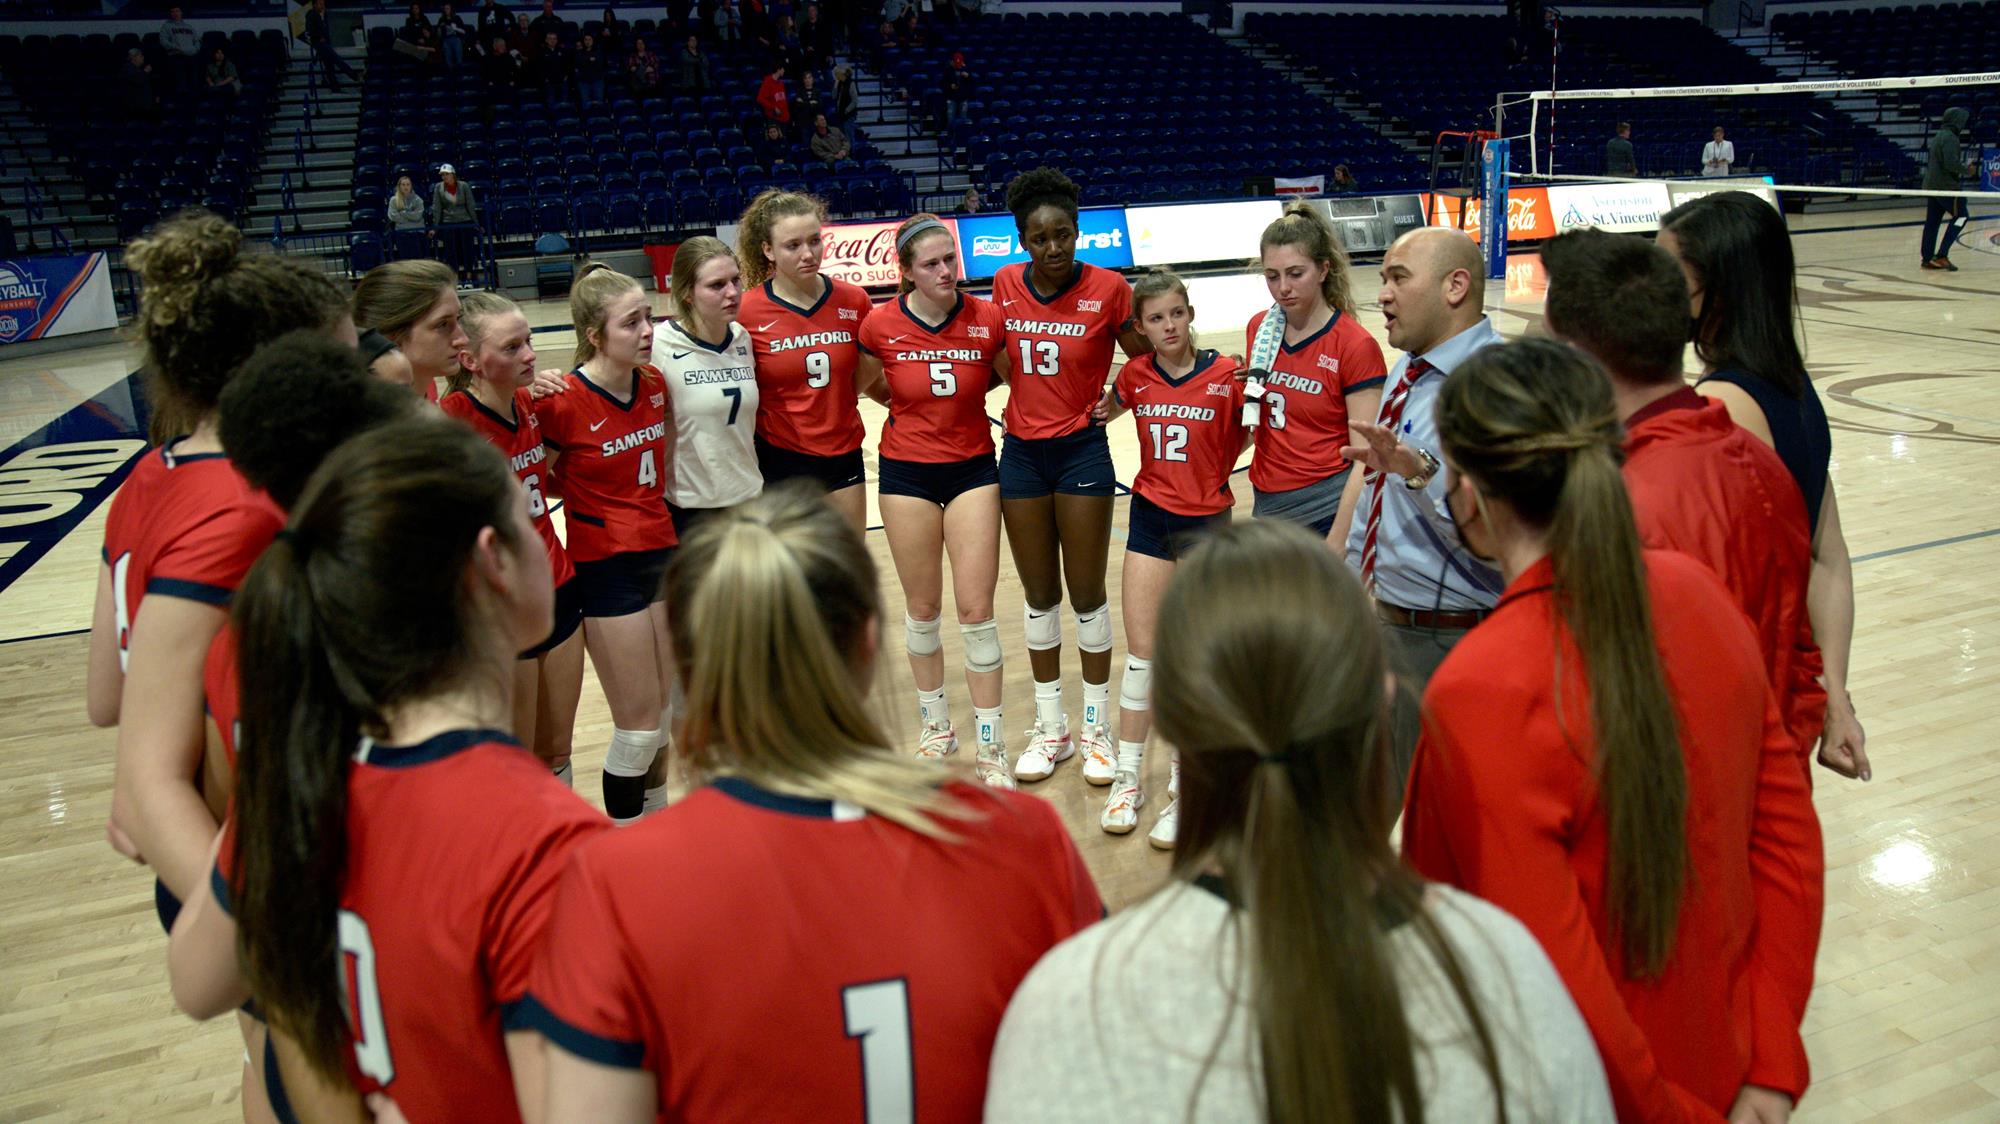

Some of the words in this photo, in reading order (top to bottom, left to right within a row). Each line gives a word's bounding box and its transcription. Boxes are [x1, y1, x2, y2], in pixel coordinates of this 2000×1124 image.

[1847, 80, 1882, 88] VOLLEYBALL
[1945, 75, 1981, 84] SOUTHERN
[1393, 215, 1416, 225] GUEST
[828, 270, 862, 283] ero
[866, 269, 901, 282] SUG
[0, 283, 42, 300] YBALL
[1004, 318, 1086, 337] SAMFORD
[769, 331, 852, 353] SAMFORD
[896, 349, 982, 361] SAMFORD
[1019, 339, 1060, 377] 13
[684, 366, 754, 385] SAMFORD
[804, 351, 831, 389] 9
[928, 361, 957, 397] 5
[1266, 371, 1324, 396] MFORD
[721, 387, 742, 426] 7
[1136, 403, 1216, 423] SAMFORD
[1265, 391, 1287, 431] 3
[602, 421, 665, 458] SAMFOR
[1149, 422, 1189, 463] 12
[638, 448, 657, 489] 4
